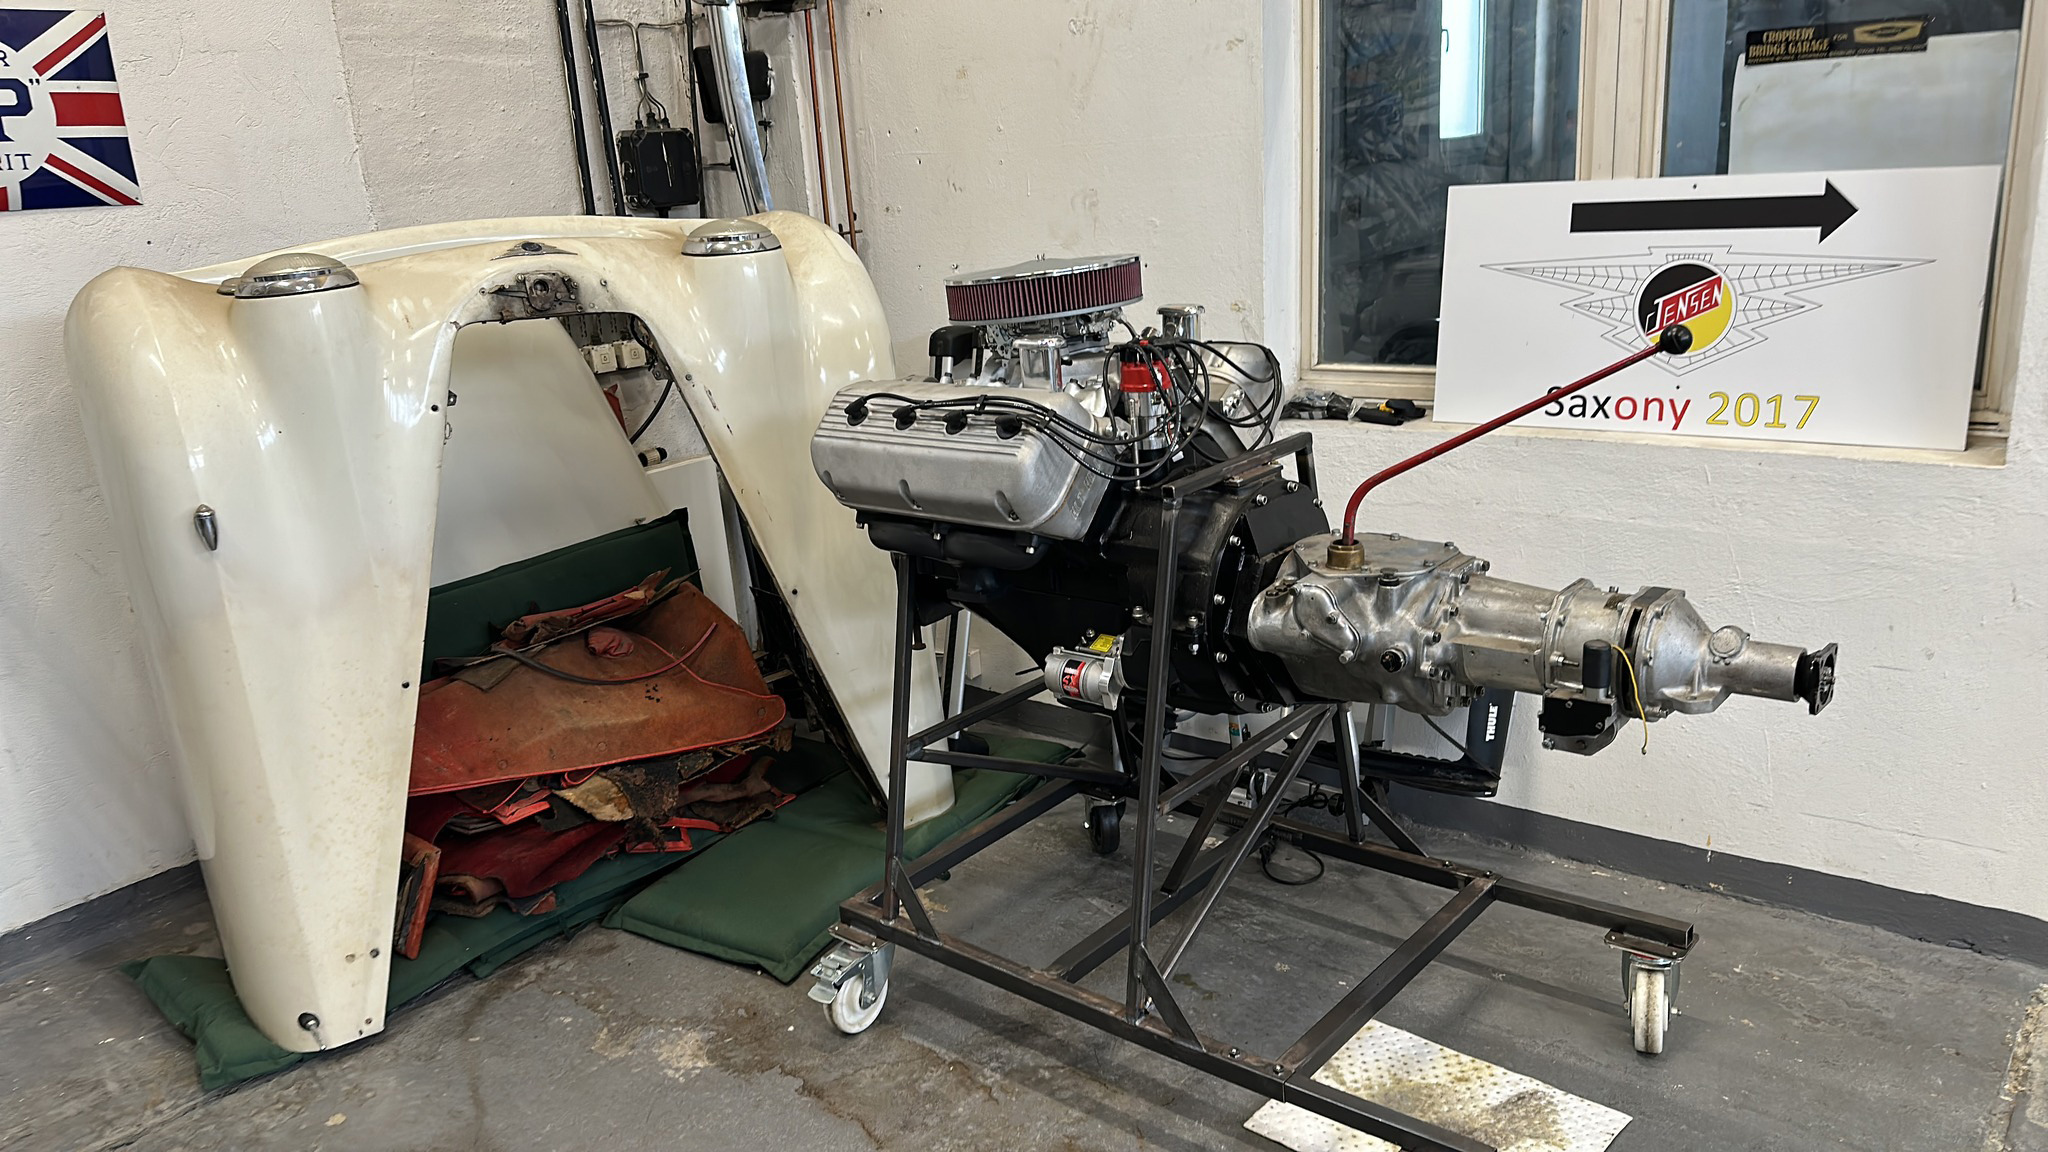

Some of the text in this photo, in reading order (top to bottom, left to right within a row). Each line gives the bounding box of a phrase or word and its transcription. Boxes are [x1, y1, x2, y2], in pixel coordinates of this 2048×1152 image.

[1748, 42, 1786, 58] BRIDGE
[1788, 38, 1830, 55] GARAGE
[0, 153, 32, 170] IT
[1645, 275, 1724, 334] JENSEN
[1544, 386, 1820, 431] Saxony 2017
[1485, 704, 1498, 742] THULE
